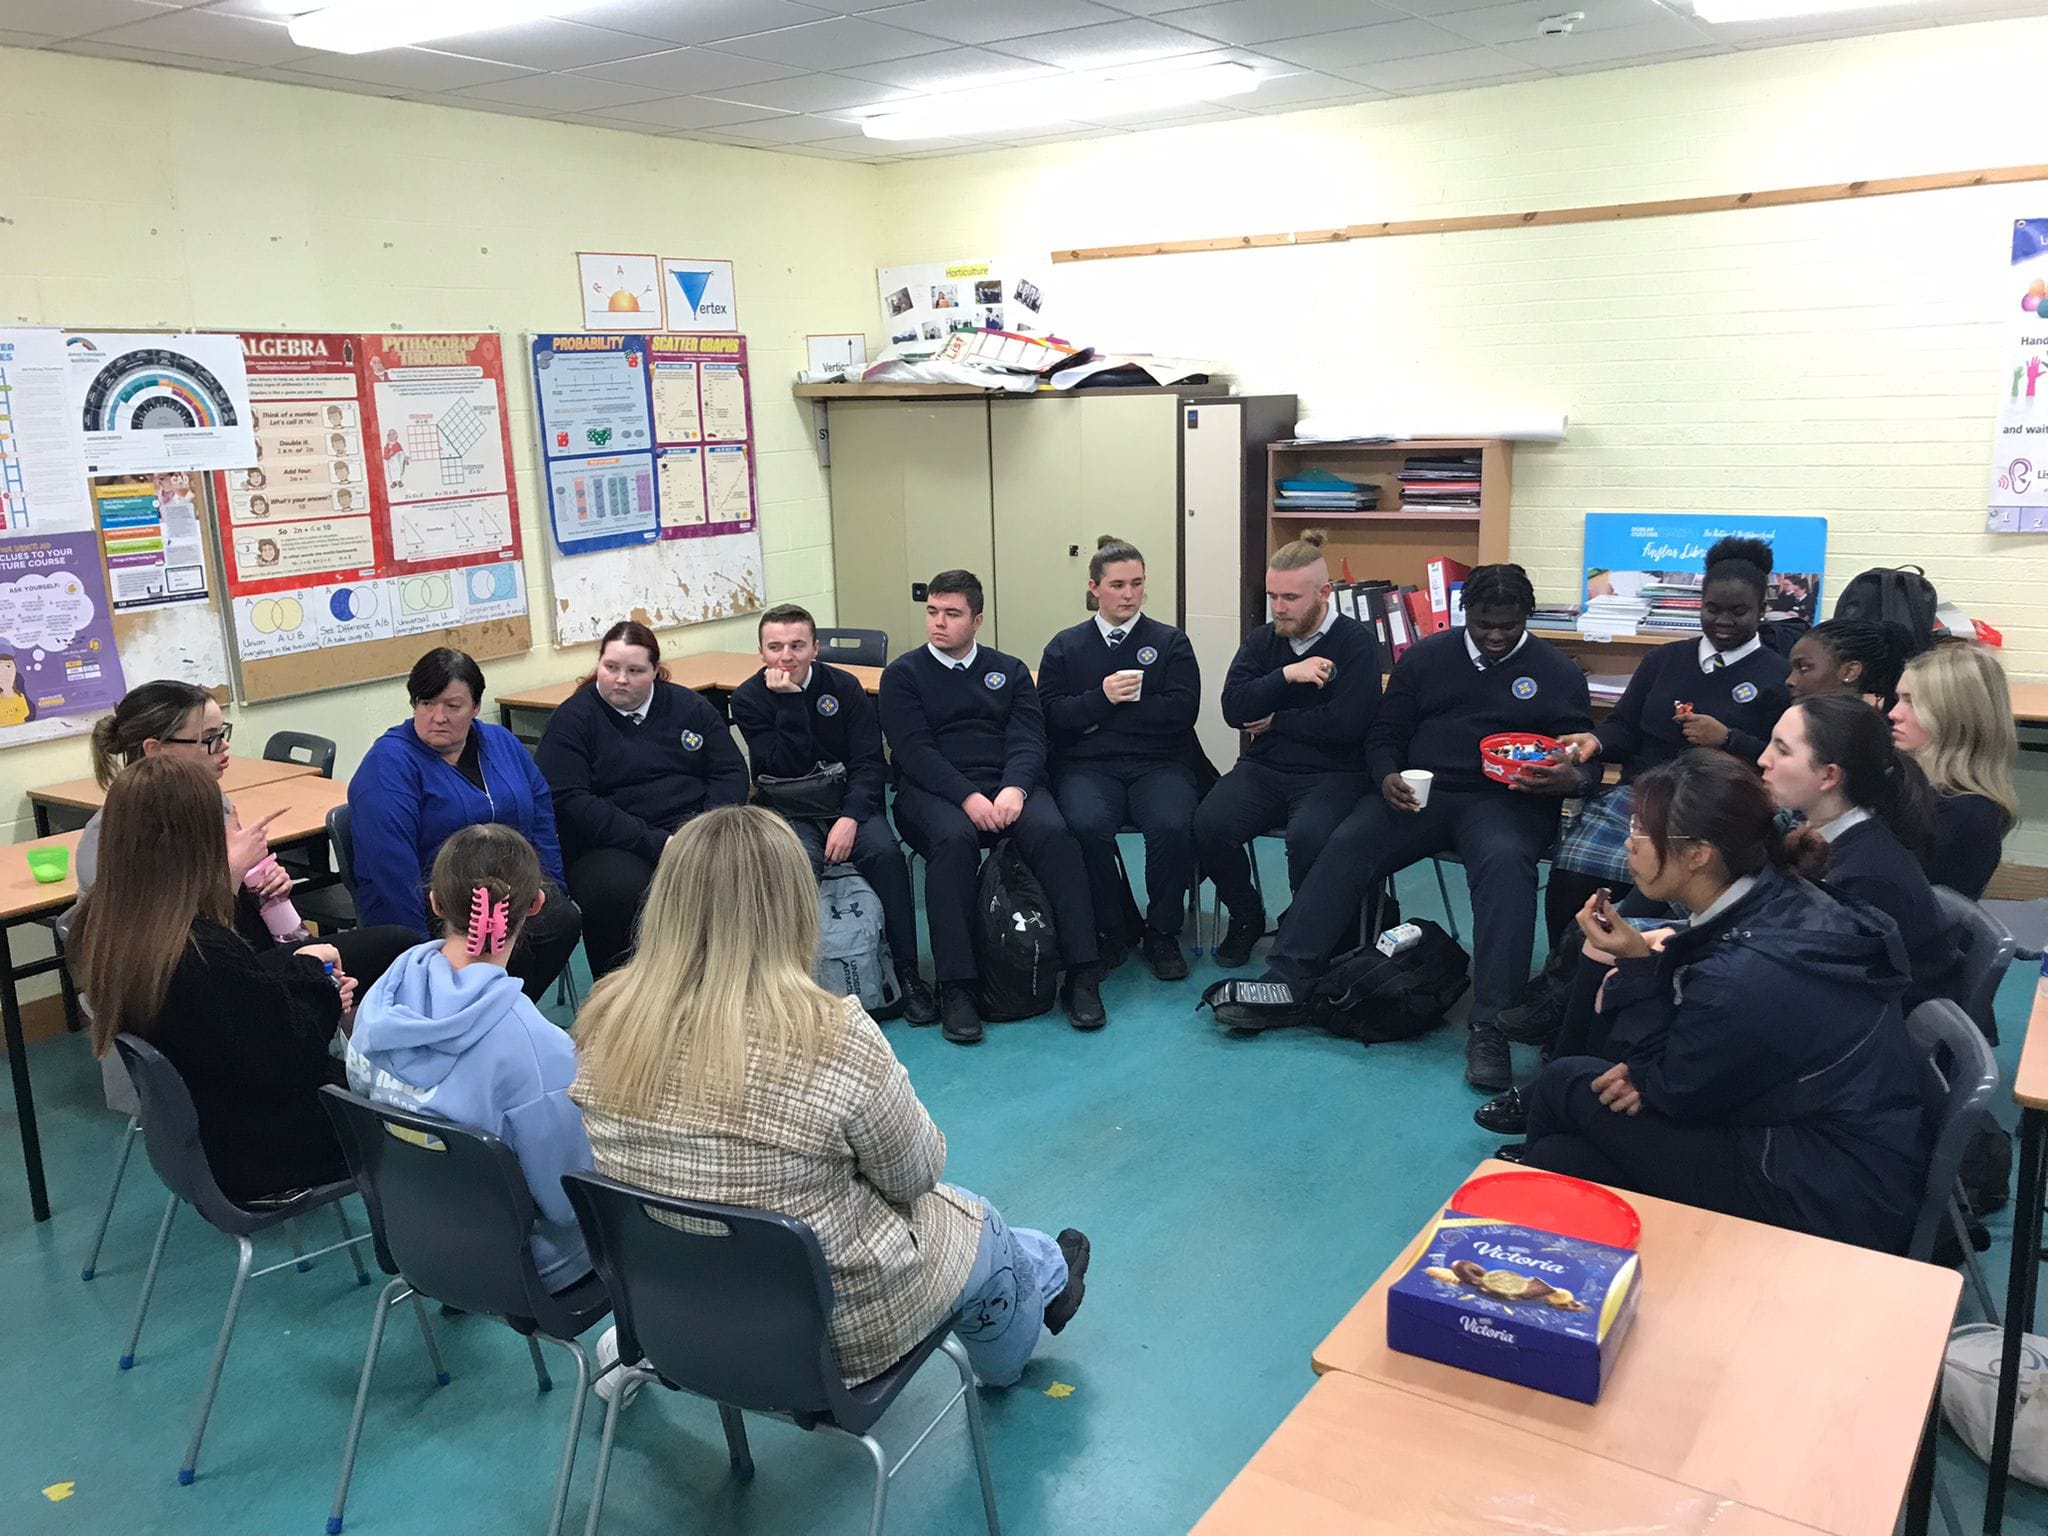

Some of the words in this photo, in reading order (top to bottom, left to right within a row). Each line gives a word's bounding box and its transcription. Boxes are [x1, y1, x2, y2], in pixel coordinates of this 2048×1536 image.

[946, 267, 989, 277] Horticulture
[553, 336, 625, 350] PROBABILITY
[652, 337, 698, 352] SCATTER
[2003, 425, 2023, 434] and
[292, 497, 307, 505] your
[0, 553, 30, 562] CLUES
[32, 551, 44, 559] TO
[47, 548, 73, 557] YOUR
[1642, 542, 1679, 562] Finglas
[0, 561, 26, 570] TURE
[28, 557, 66, 568] COURSE
[9, 586, 22, 594] ASK
[246, 598, 254, 607] A
[397, 615, 429, 626] Universal
[320, 627, 334, 636] Set
[336, 623, 371, 634] Difference
[243, 639, 267, 648] Union
[843, 964, 854, 995] ARMO
[850, 960, 861, 995] UNDER
[1473, 1241, 1566, 1274] Victoria
[1459, 1315, 1515, 1344] Victoria
